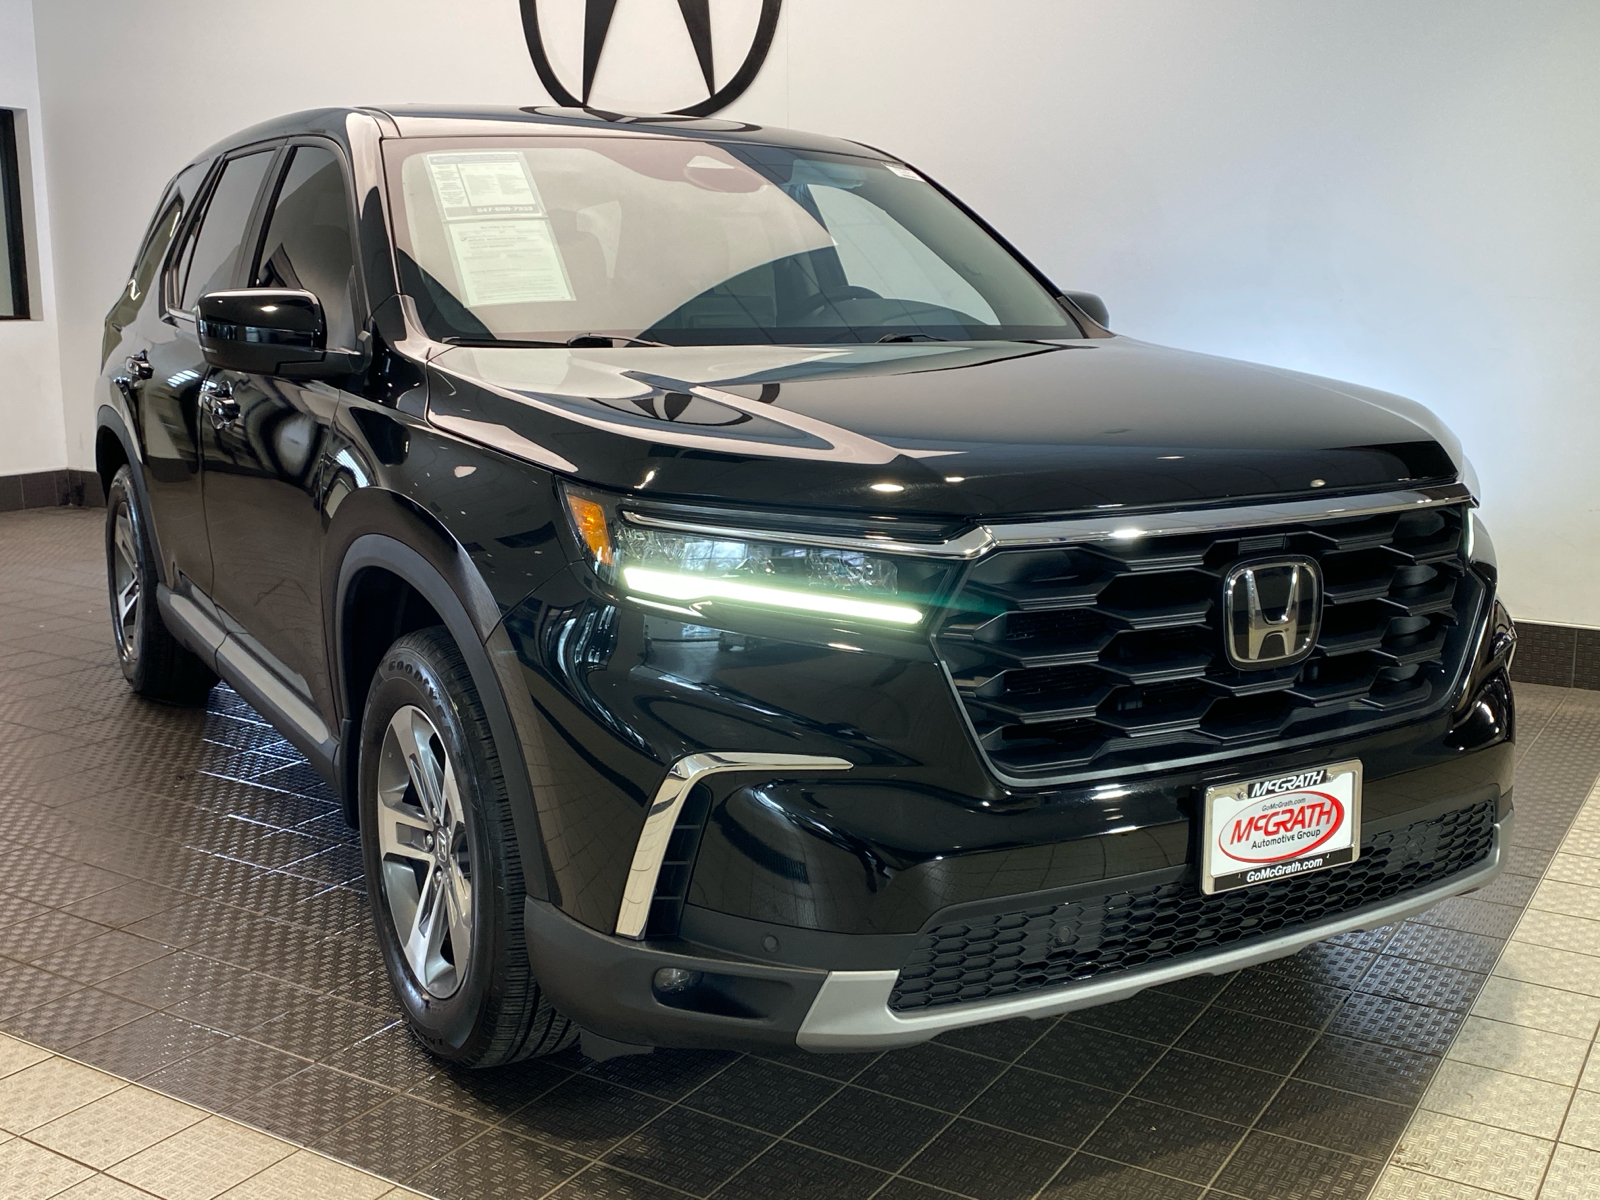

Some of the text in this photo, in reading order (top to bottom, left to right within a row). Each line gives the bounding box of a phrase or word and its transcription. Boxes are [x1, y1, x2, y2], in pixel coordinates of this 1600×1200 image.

[1251, 769, 1324, 798] McGRATH
[1261, 797, 1307, 812] GoMcGrath.com
[1229, 801, 1335, 845] McGRATH
[1251, 828, 1321, 849] Automotive Group
[1246, 857, 1323, 883] GoMcGrath.com
